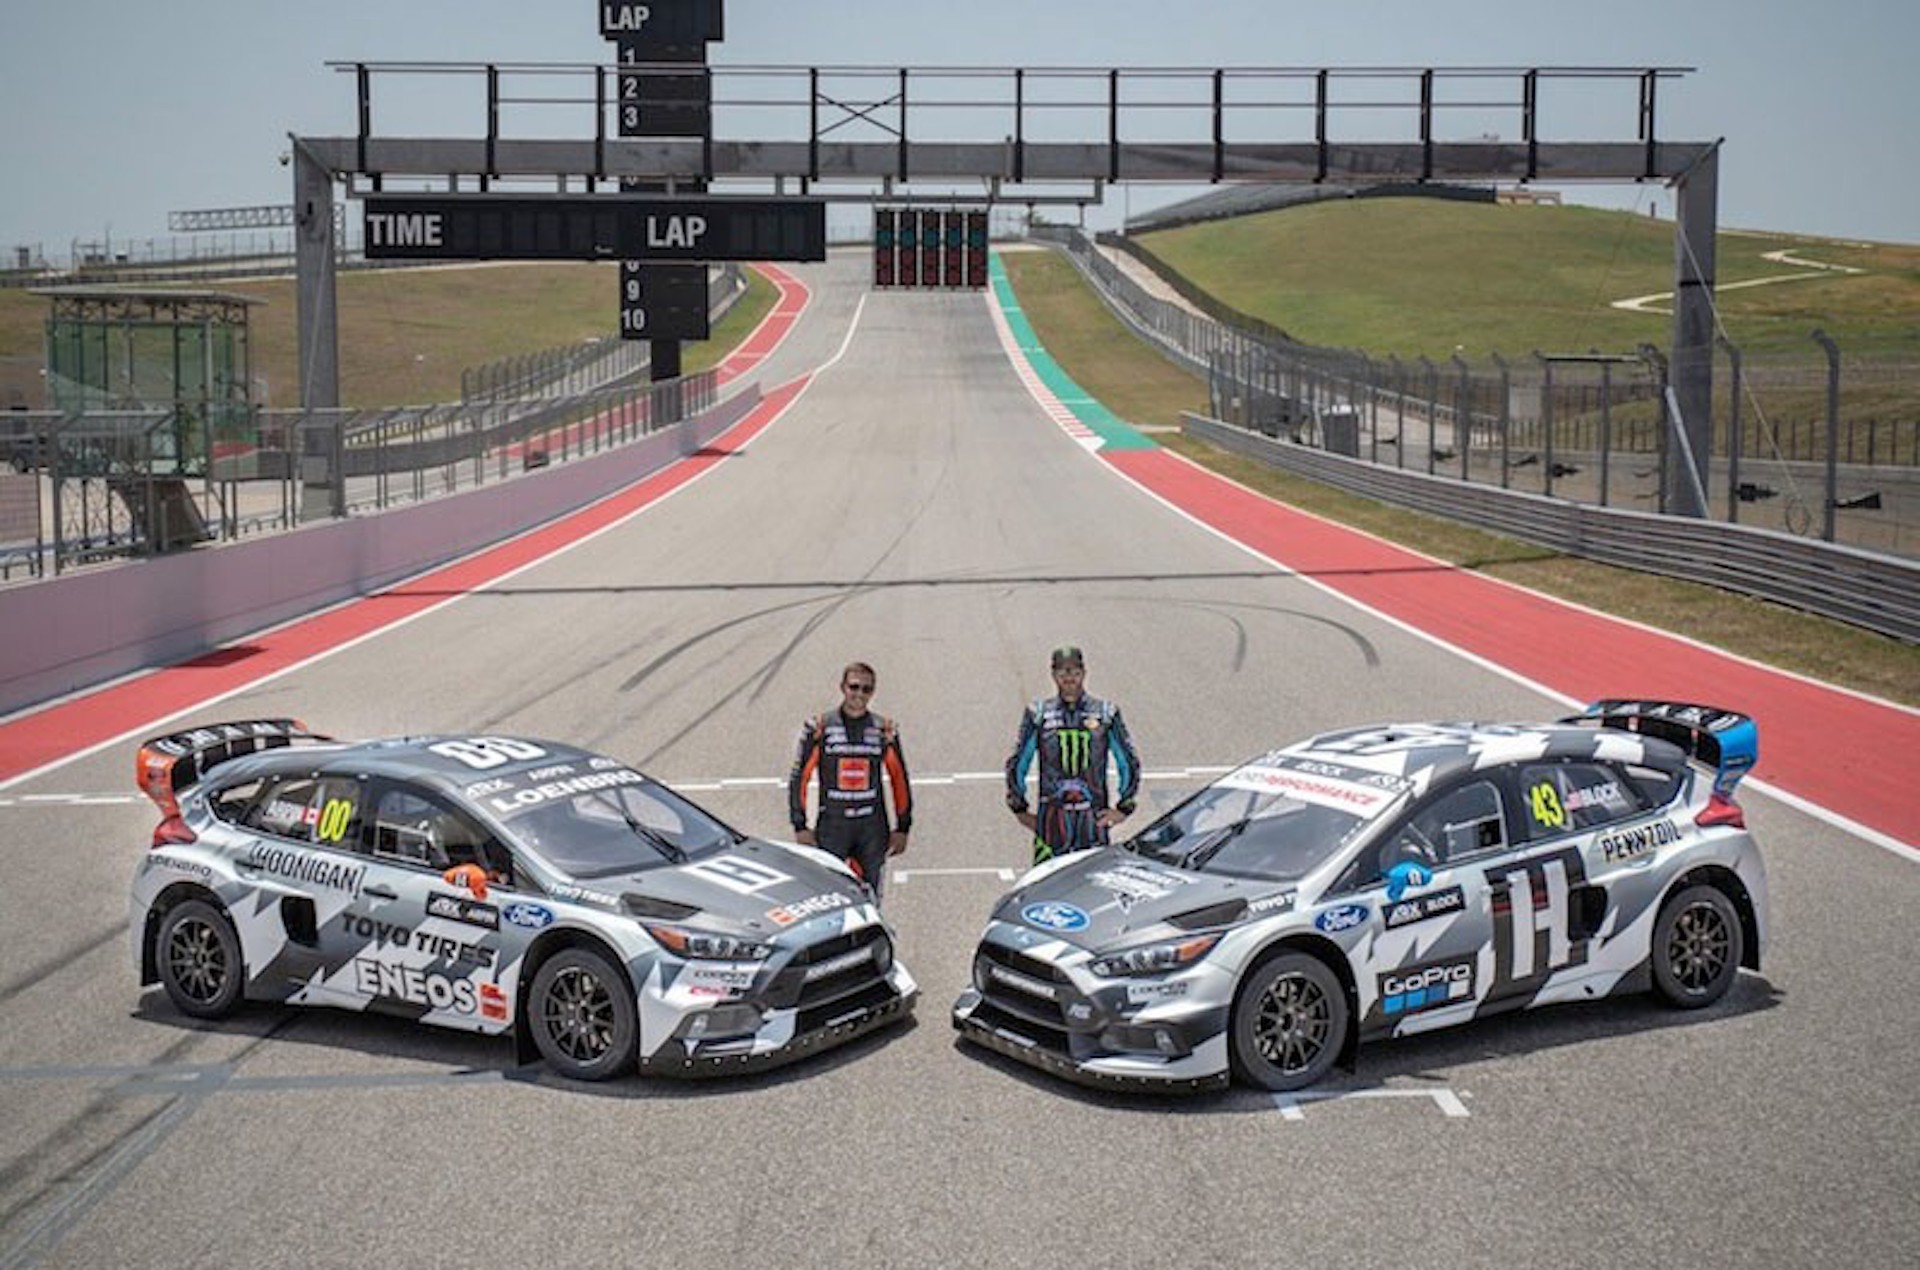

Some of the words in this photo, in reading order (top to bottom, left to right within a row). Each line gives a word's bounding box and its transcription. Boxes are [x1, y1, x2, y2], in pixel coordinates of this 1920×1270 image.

[604, 6, 650, 30] LAP
[624, 48, 635, 65] 1
[624, 77, 637, 97] 2
[625, 107, 638, 128] 3
[367, 214, 442, 246] TIME
[647, 216, 707, 247] LAP
[627, 279, 639, 300] 9
[621, 308, 645, 330] 10
[490, 769, 644, 812] LOENBRO
[1531, 782, 1564, 827] 43
[319, 798, 351, 841] 00
[1601, 818, 1684, 862] PENNZOIL
[786, 890, 852, 918] ENEOS
[342, 911, 411, 947] TOYO
[414, 931, 497, 968] TIRES
[355, 956, 479, 1015] ENEOS
[1383, 963, 1471, 996] GoPro
